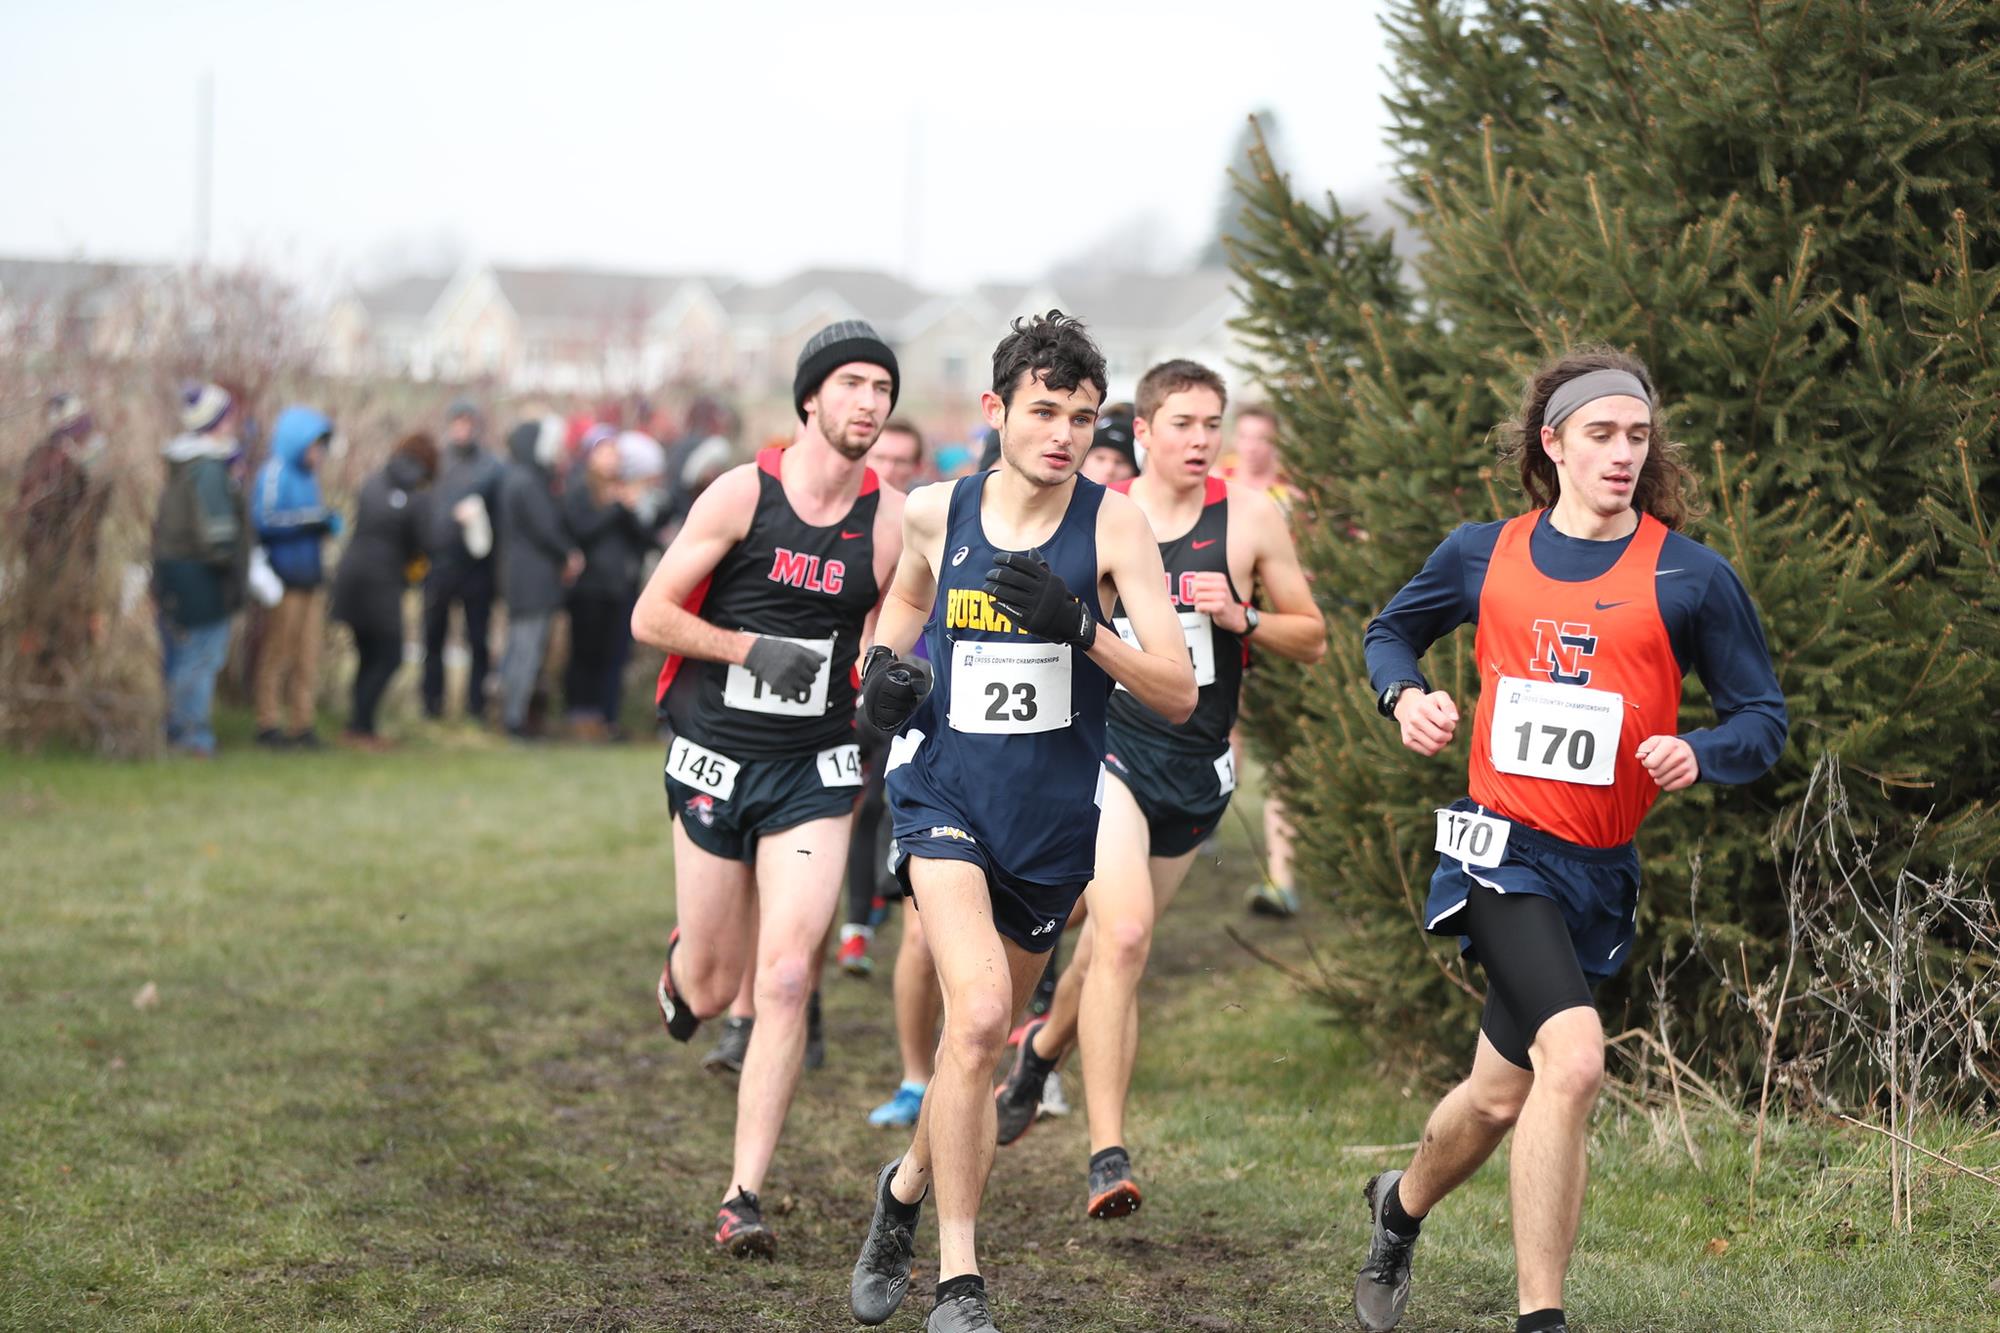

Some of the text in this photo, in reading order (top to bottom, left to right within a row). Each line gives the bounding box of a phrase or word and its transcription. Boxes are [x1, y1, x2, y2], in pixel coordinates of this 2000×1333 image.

[768, 547, 846, 595] MLC
[1016, 656, 1060, 665] CHAMPIONSHIPS
[1529, 619, 1598, 688] NC
[984, 682, 1038, 722] 23
[1539, 697, 1565, 706] COUNTRY
[1565, 702, 1610, 713] CHAMPIONSHIPS
[828, 751, 863, 778] 14
[1514, 721, 1595, 770] 170
[676, 748, 726, 787] 145
[1448, 815, 1493, 857] 170
